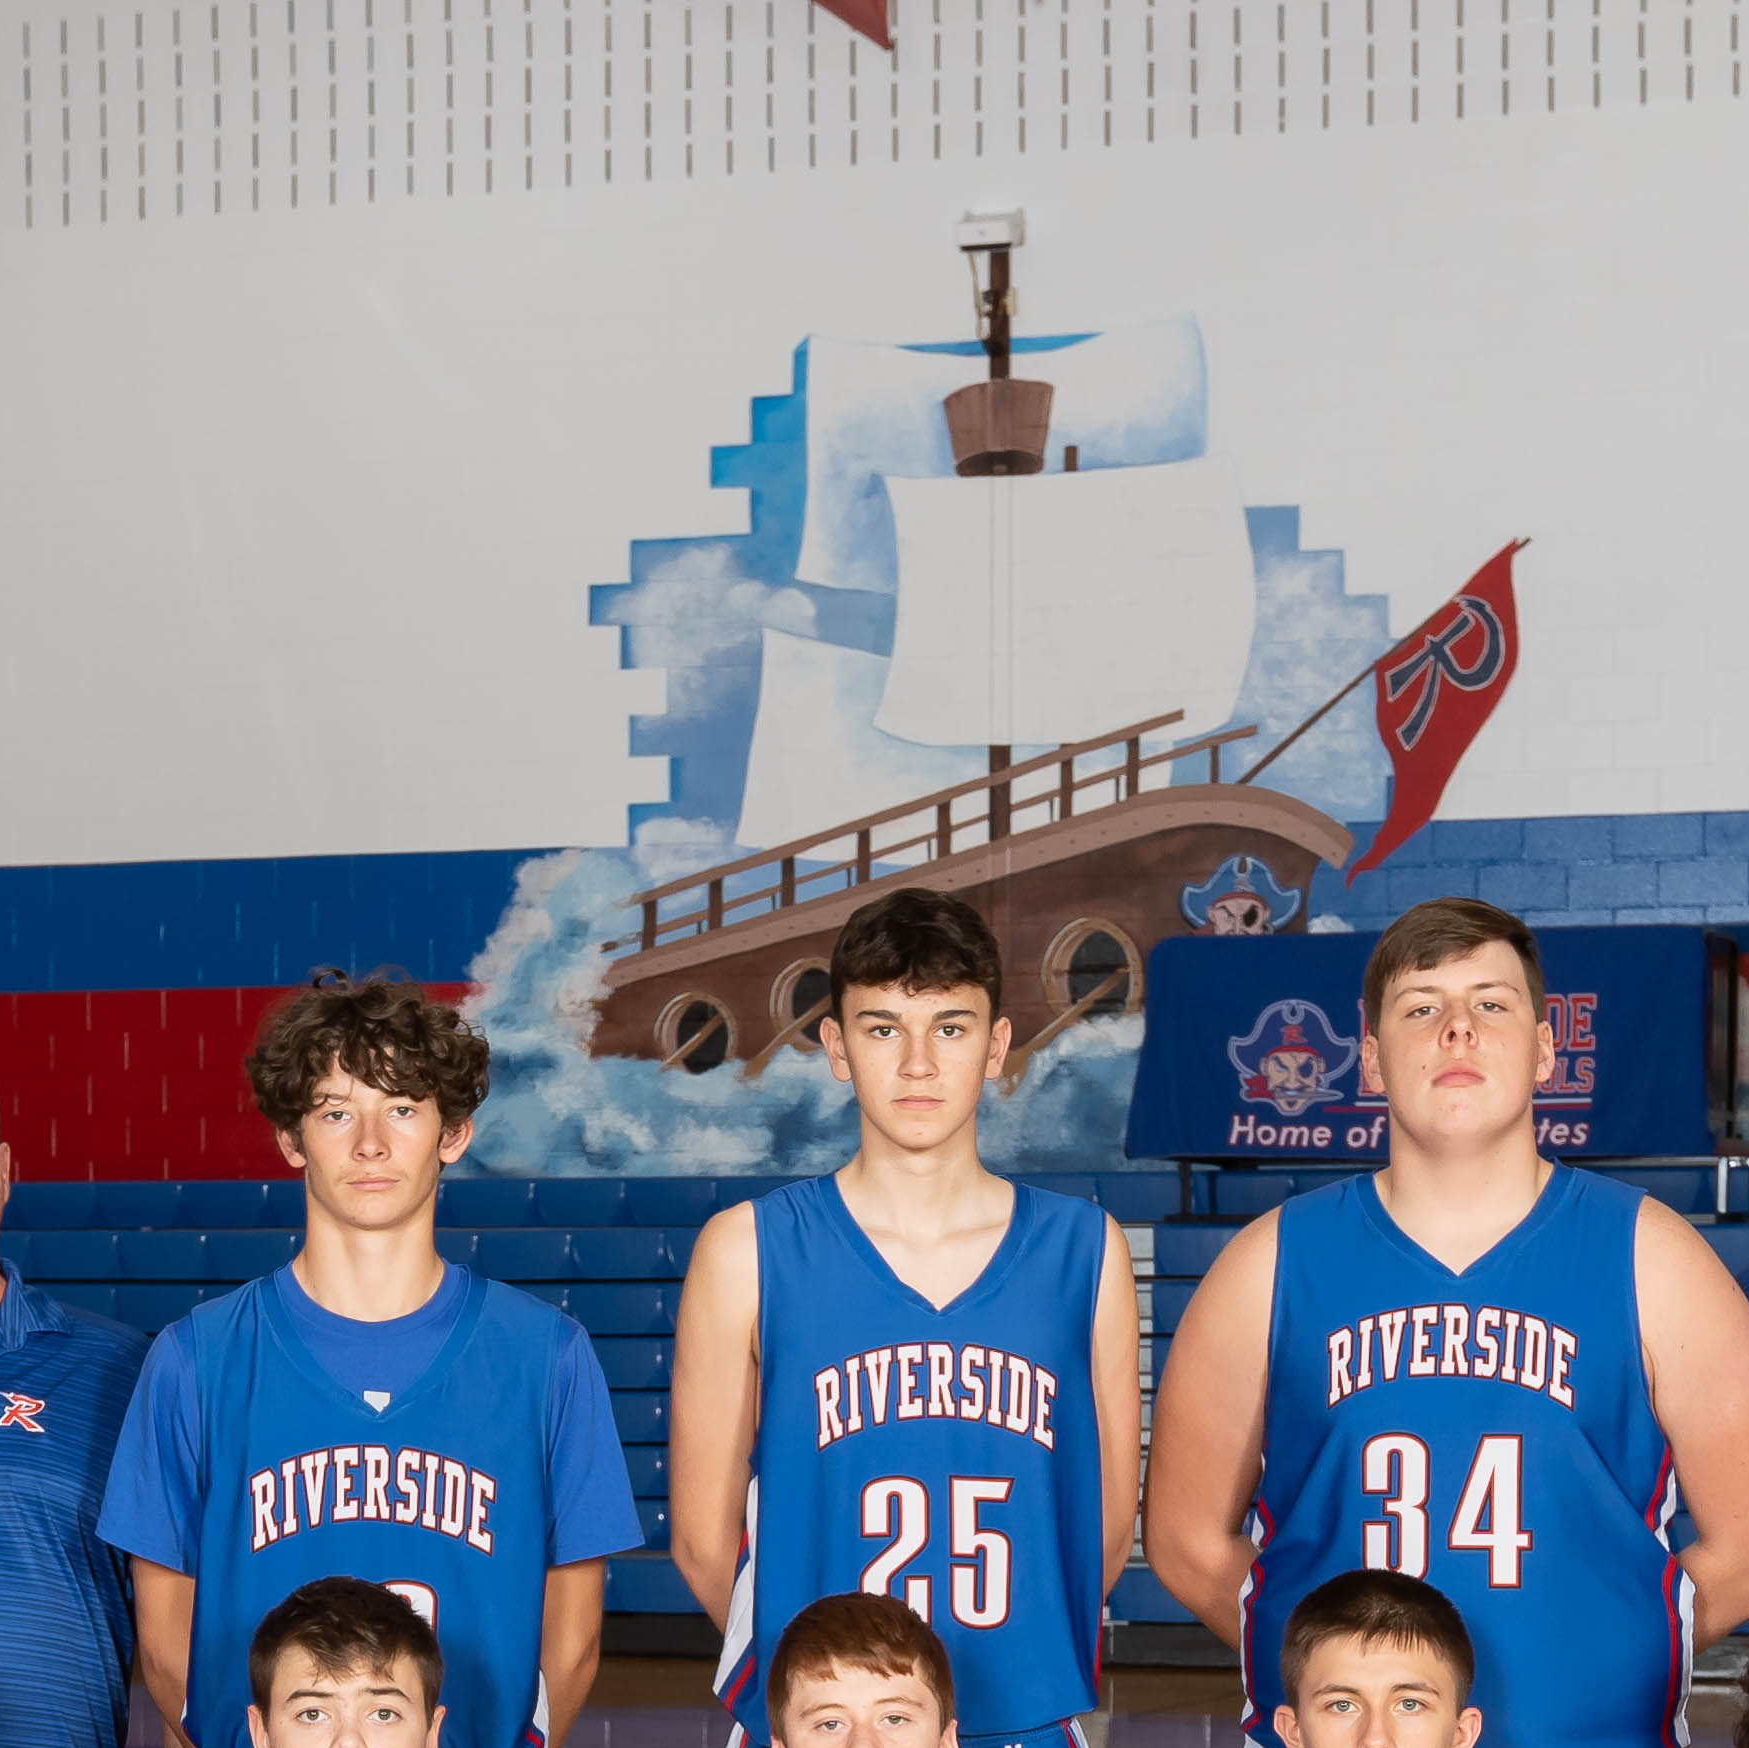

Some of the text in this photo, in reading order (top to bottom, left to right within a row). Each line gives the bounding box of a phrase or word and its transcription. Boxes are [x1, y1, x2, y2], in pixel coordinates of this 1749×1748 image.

[1385, 594, 1505, 751] R
[1228, 1114, 1387, 1149] Home of
[814, 1341, 1057, 1451] RIVERSIDE
[1327, 1303, 1578, 1411] RIVERSIDE
[250, 1444, 497, 1556] RIVERSIDE
[859, 1474, 1015, 1630] 25
[1362, 1431, 1533, 1589] 34
